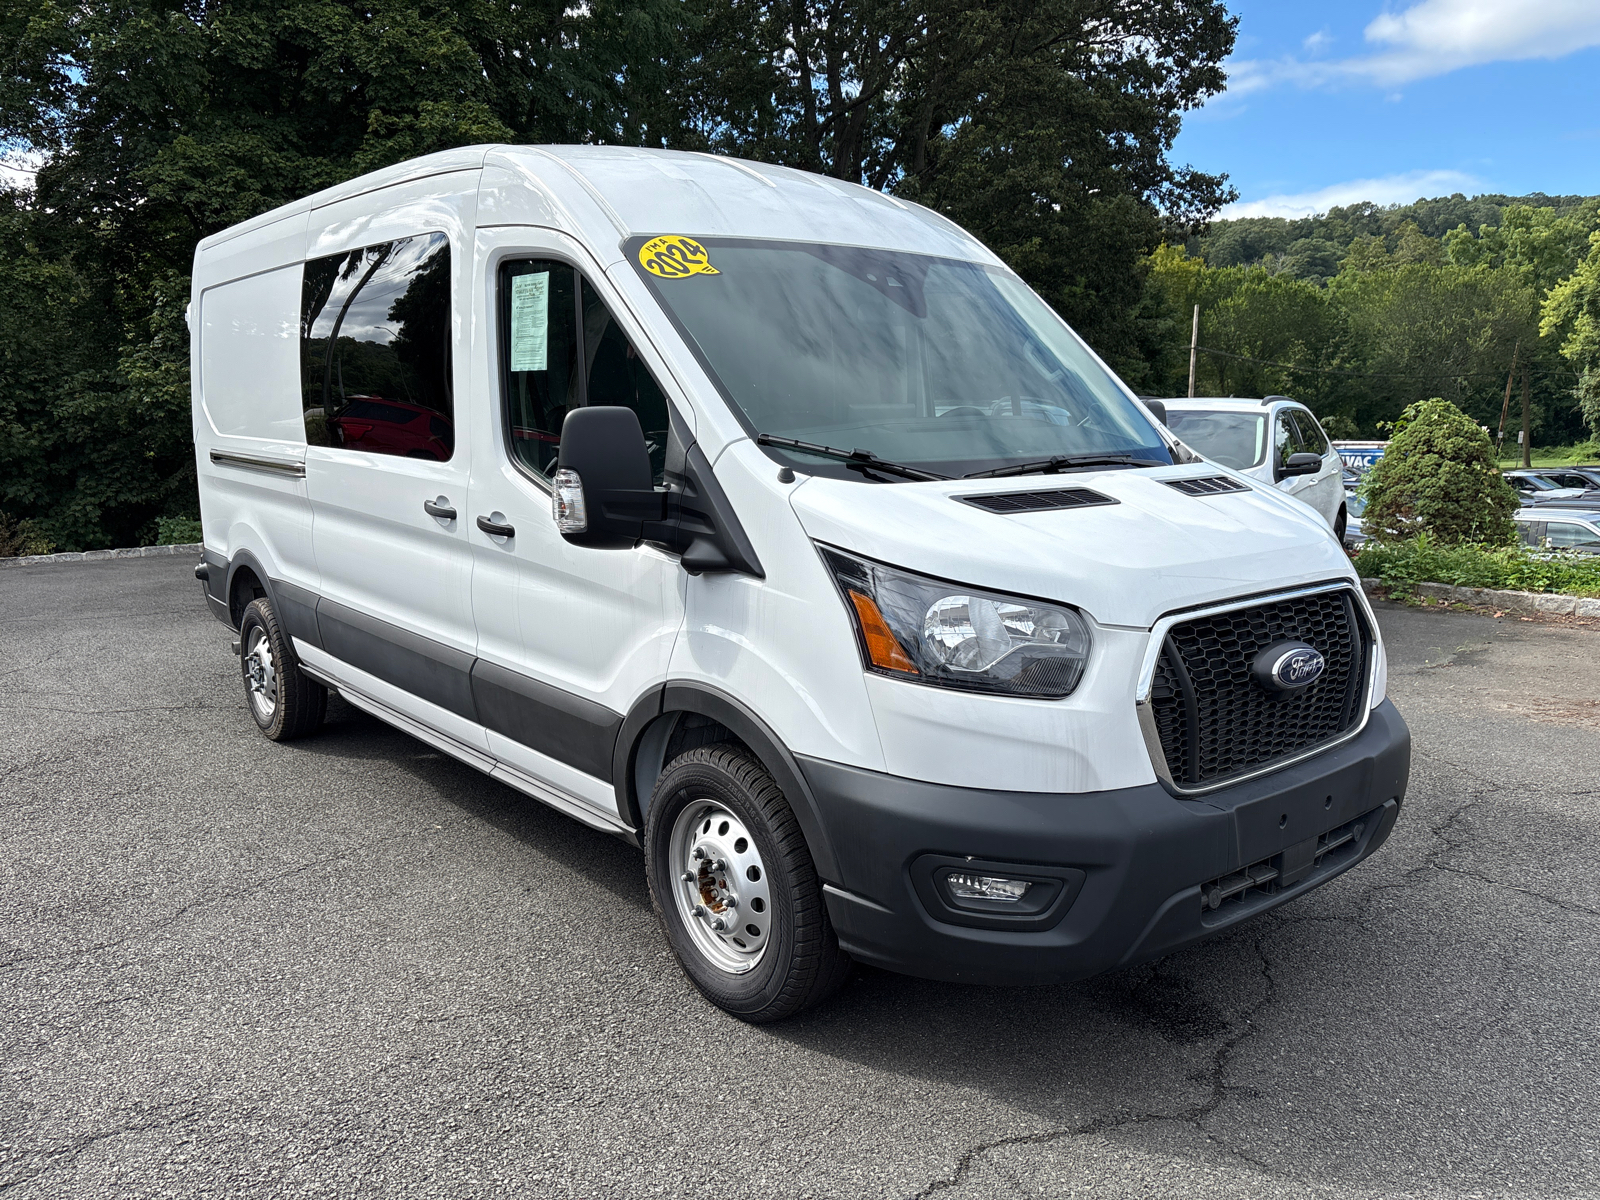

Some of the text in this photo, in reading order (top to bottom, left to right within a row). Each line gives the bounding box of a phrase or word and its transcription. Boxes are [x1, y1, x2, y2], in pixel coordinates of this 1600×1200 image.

[645, 238, 668, 252] I'M A
[646, 239, 706, 276] 2024
[1290, 654, 1323, 680] Ford
